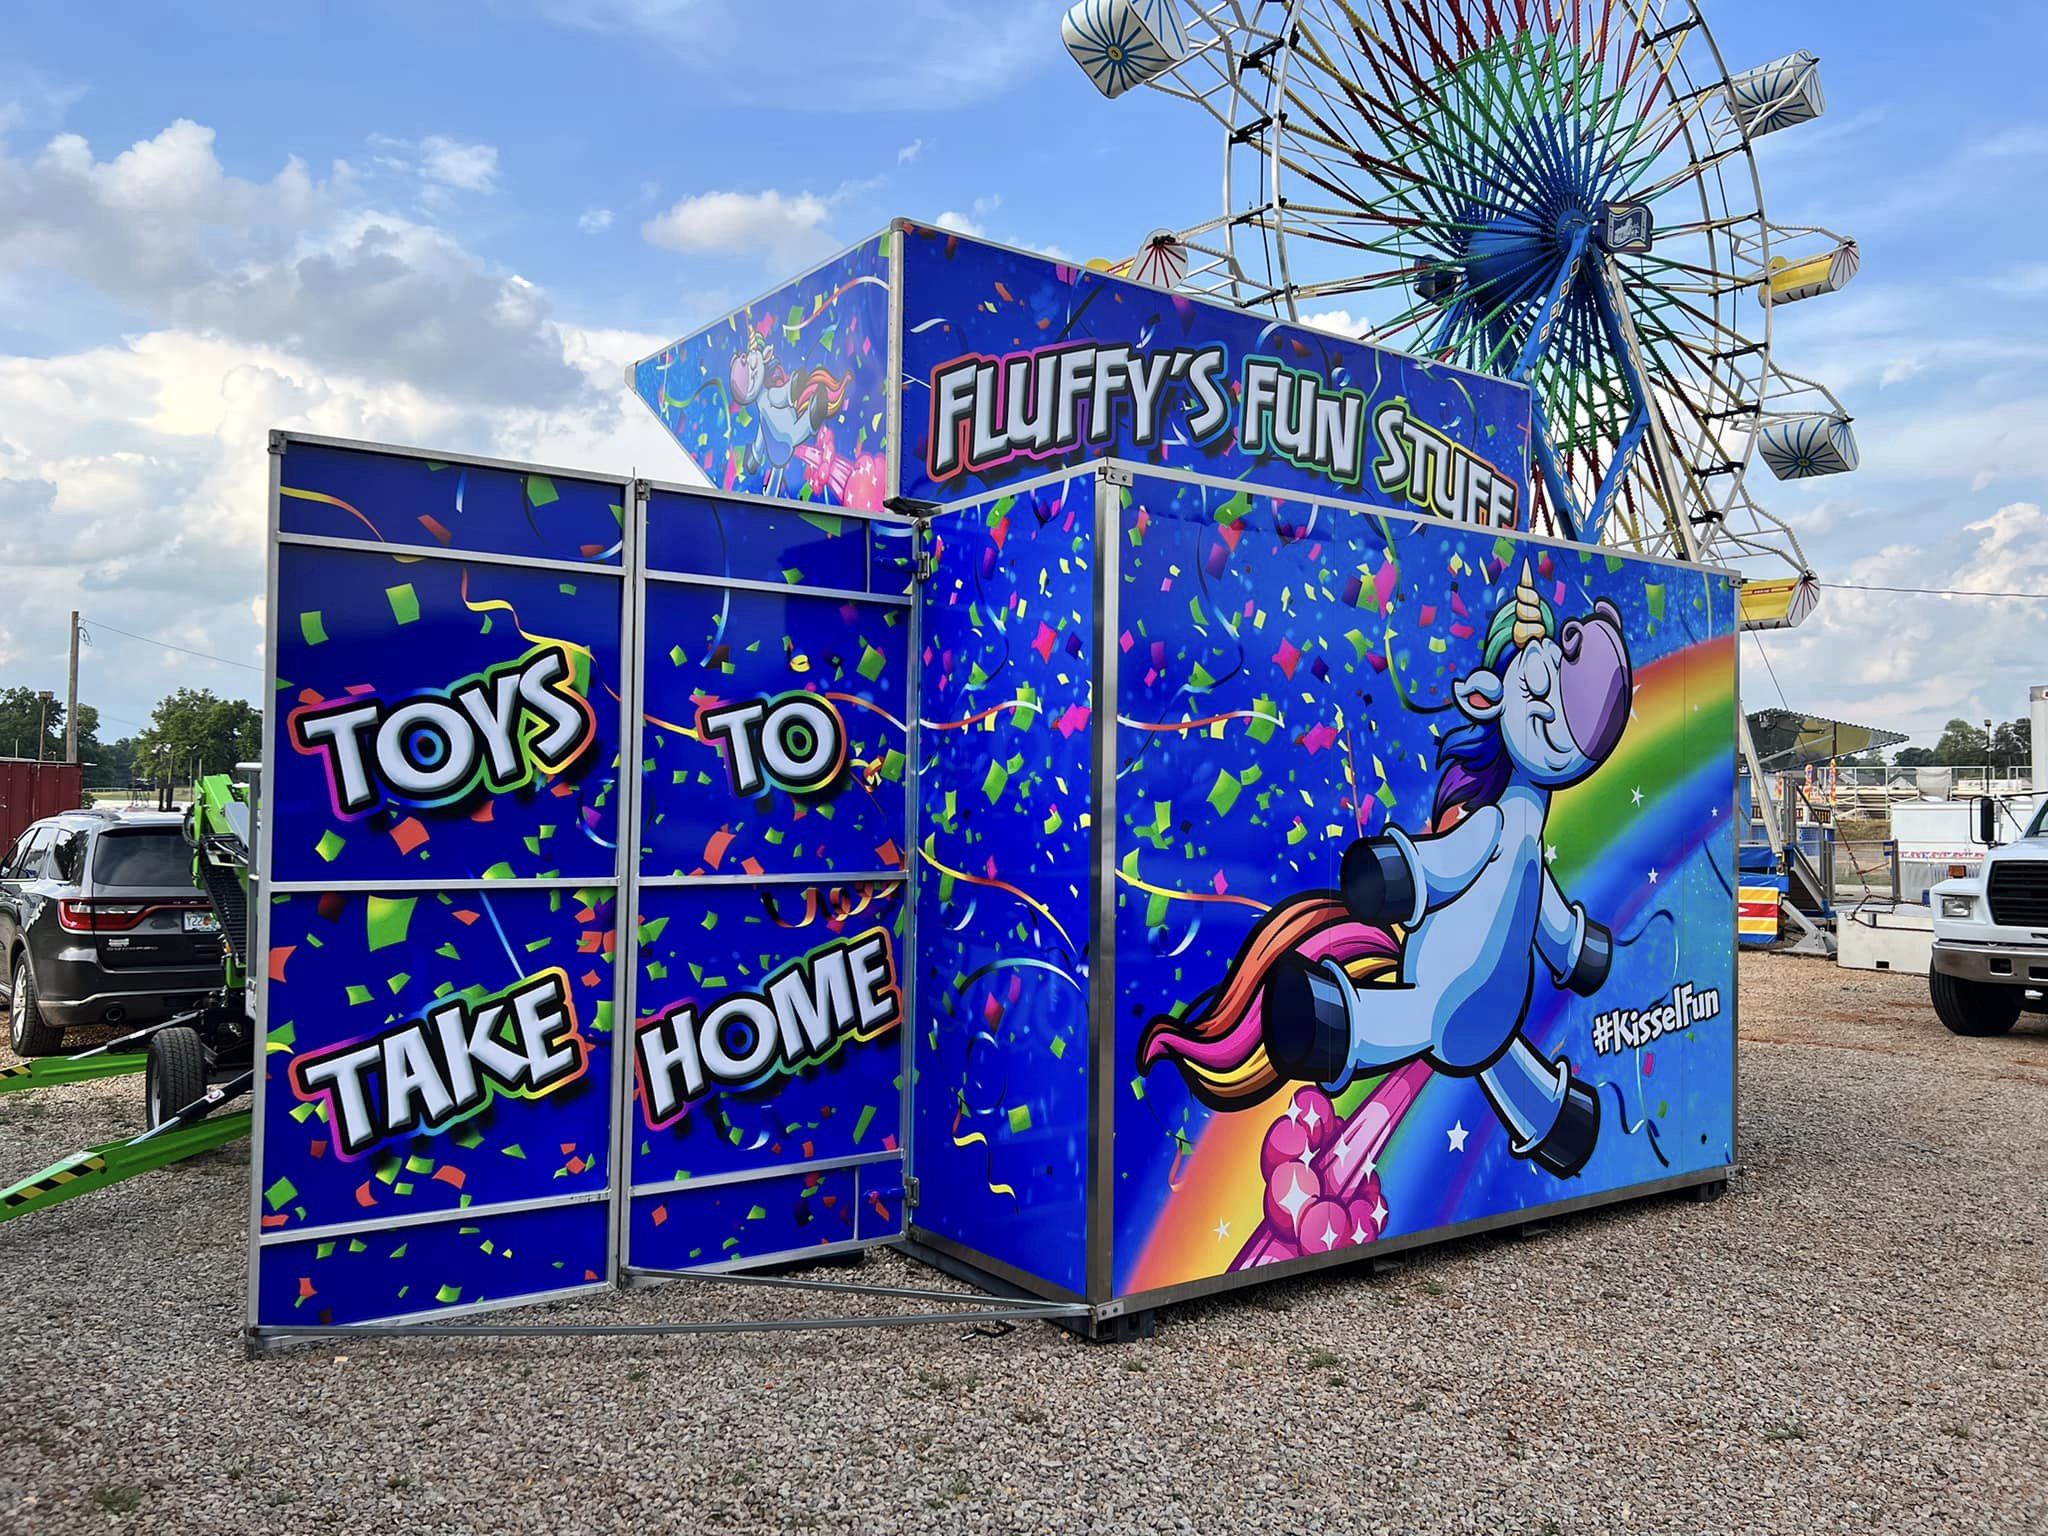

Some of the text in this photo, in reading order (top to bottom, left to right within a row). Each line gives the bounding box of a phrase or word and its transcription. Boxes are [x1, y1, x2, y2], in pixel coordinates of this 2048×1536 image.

[934, 346, 1516, 528] FLUFFY'S FUN STUFF
[302, 652, 837, 808] TOYS TO
[303, 937, 895, 1149] TAKE HOME
[1592, 982, 1721, 1055] #KisselFun
